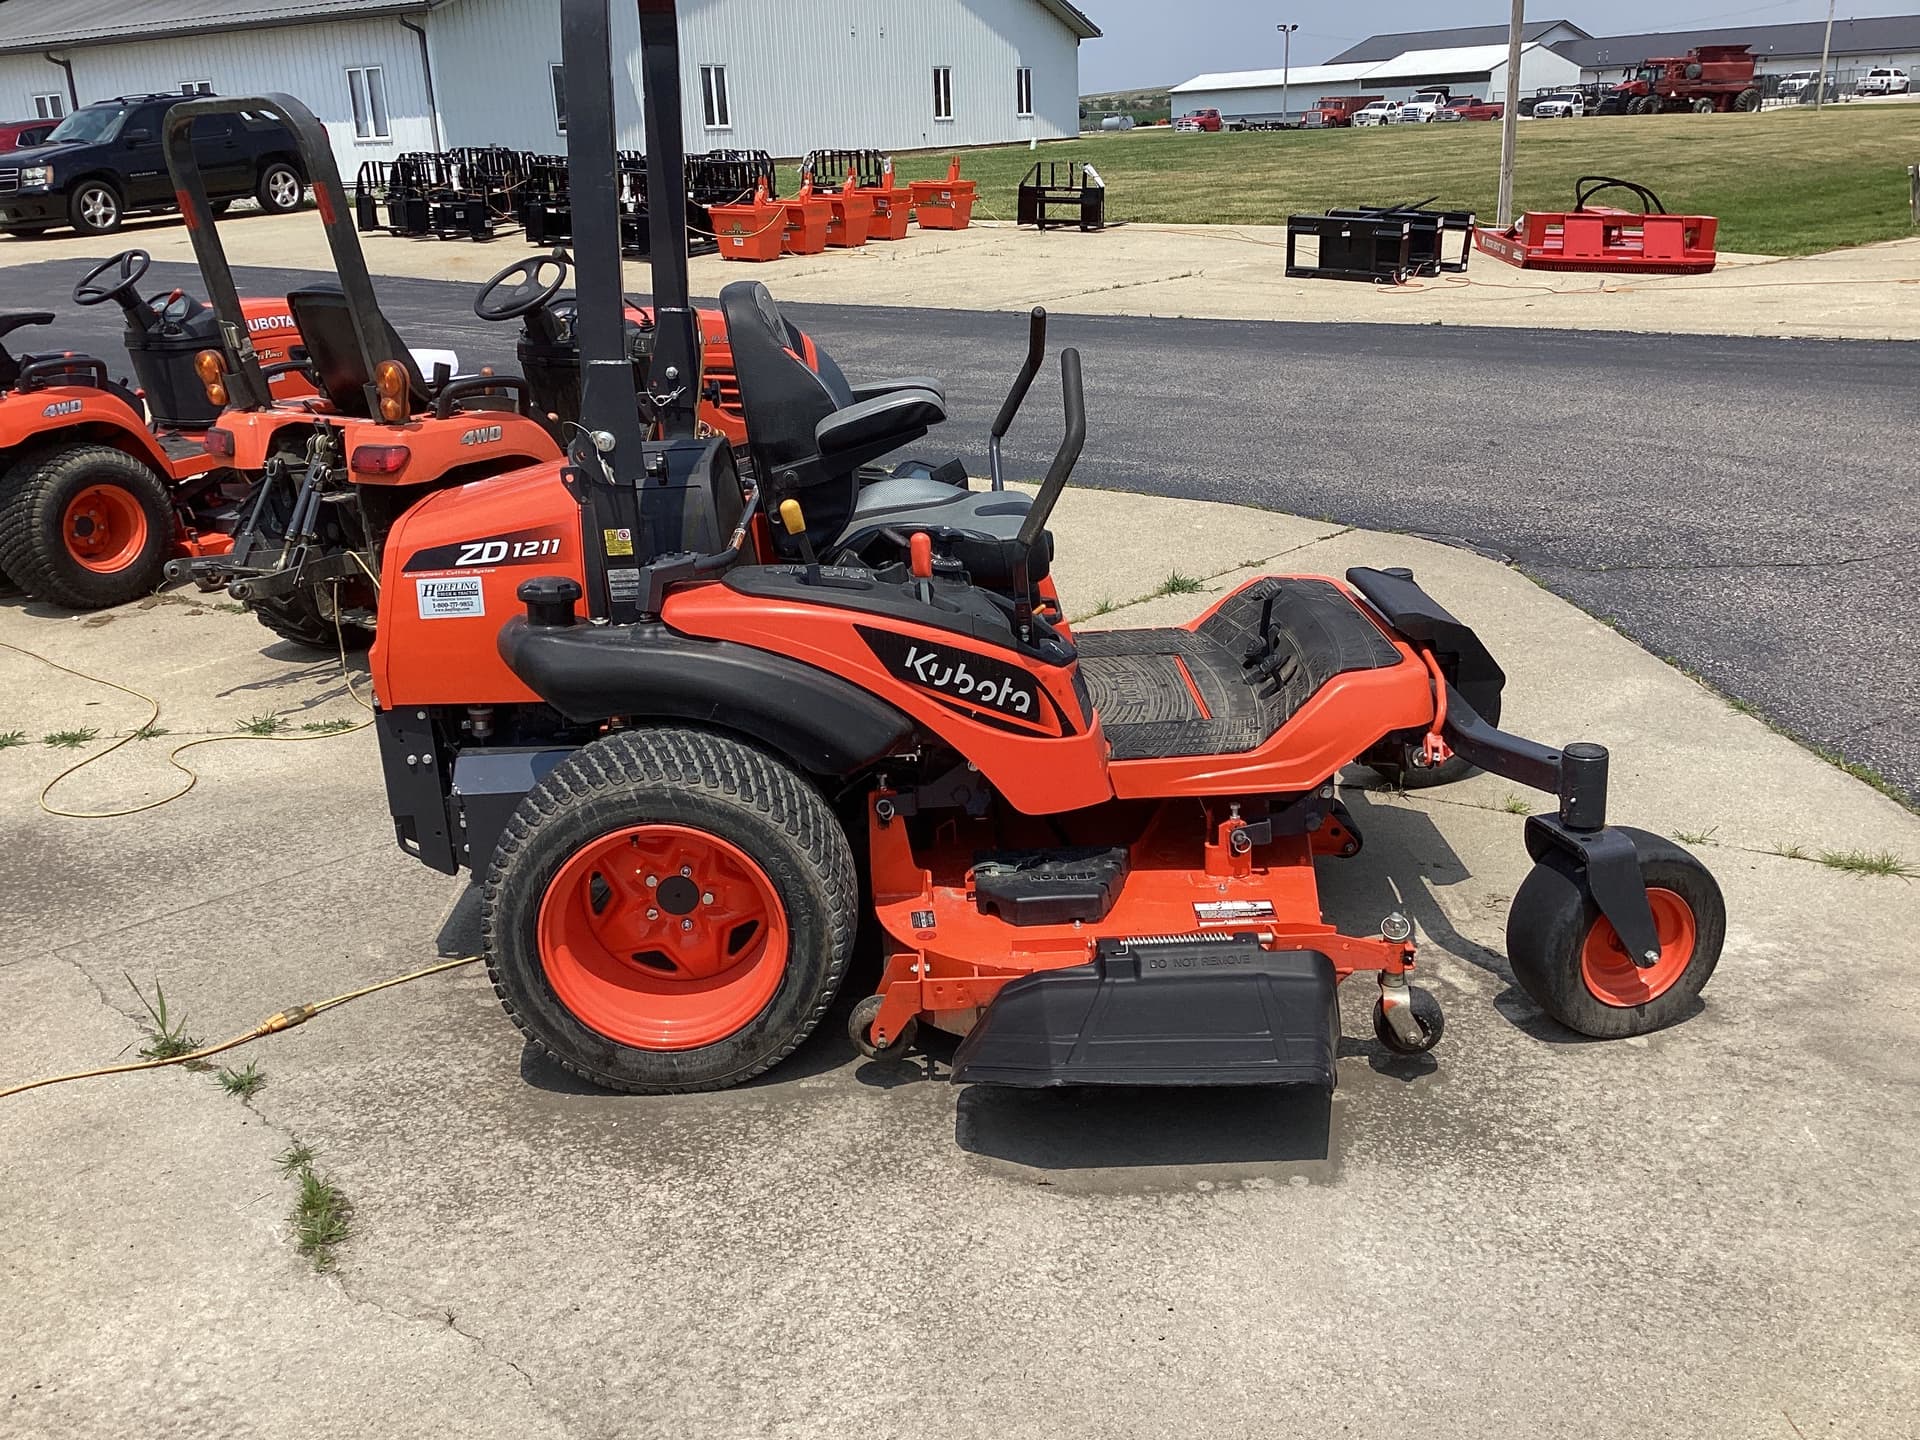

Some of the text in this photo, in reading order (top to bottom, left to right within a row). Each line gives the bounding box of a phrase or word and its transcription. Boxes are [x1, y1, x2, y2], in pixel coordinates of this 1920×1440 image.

[247, 315, 296, 333] UBOTA
[42, 399, 83, 417] 4WD
[460, 425, 502, 446] 4WD
[455, 538, 561, 566] ZD 1211
[904, 646, 1031, 714] Kubota
[1029, 871, 1097, 882] NO STEP
[1149, 954, 1251, 969] DO NOT REMOVE
